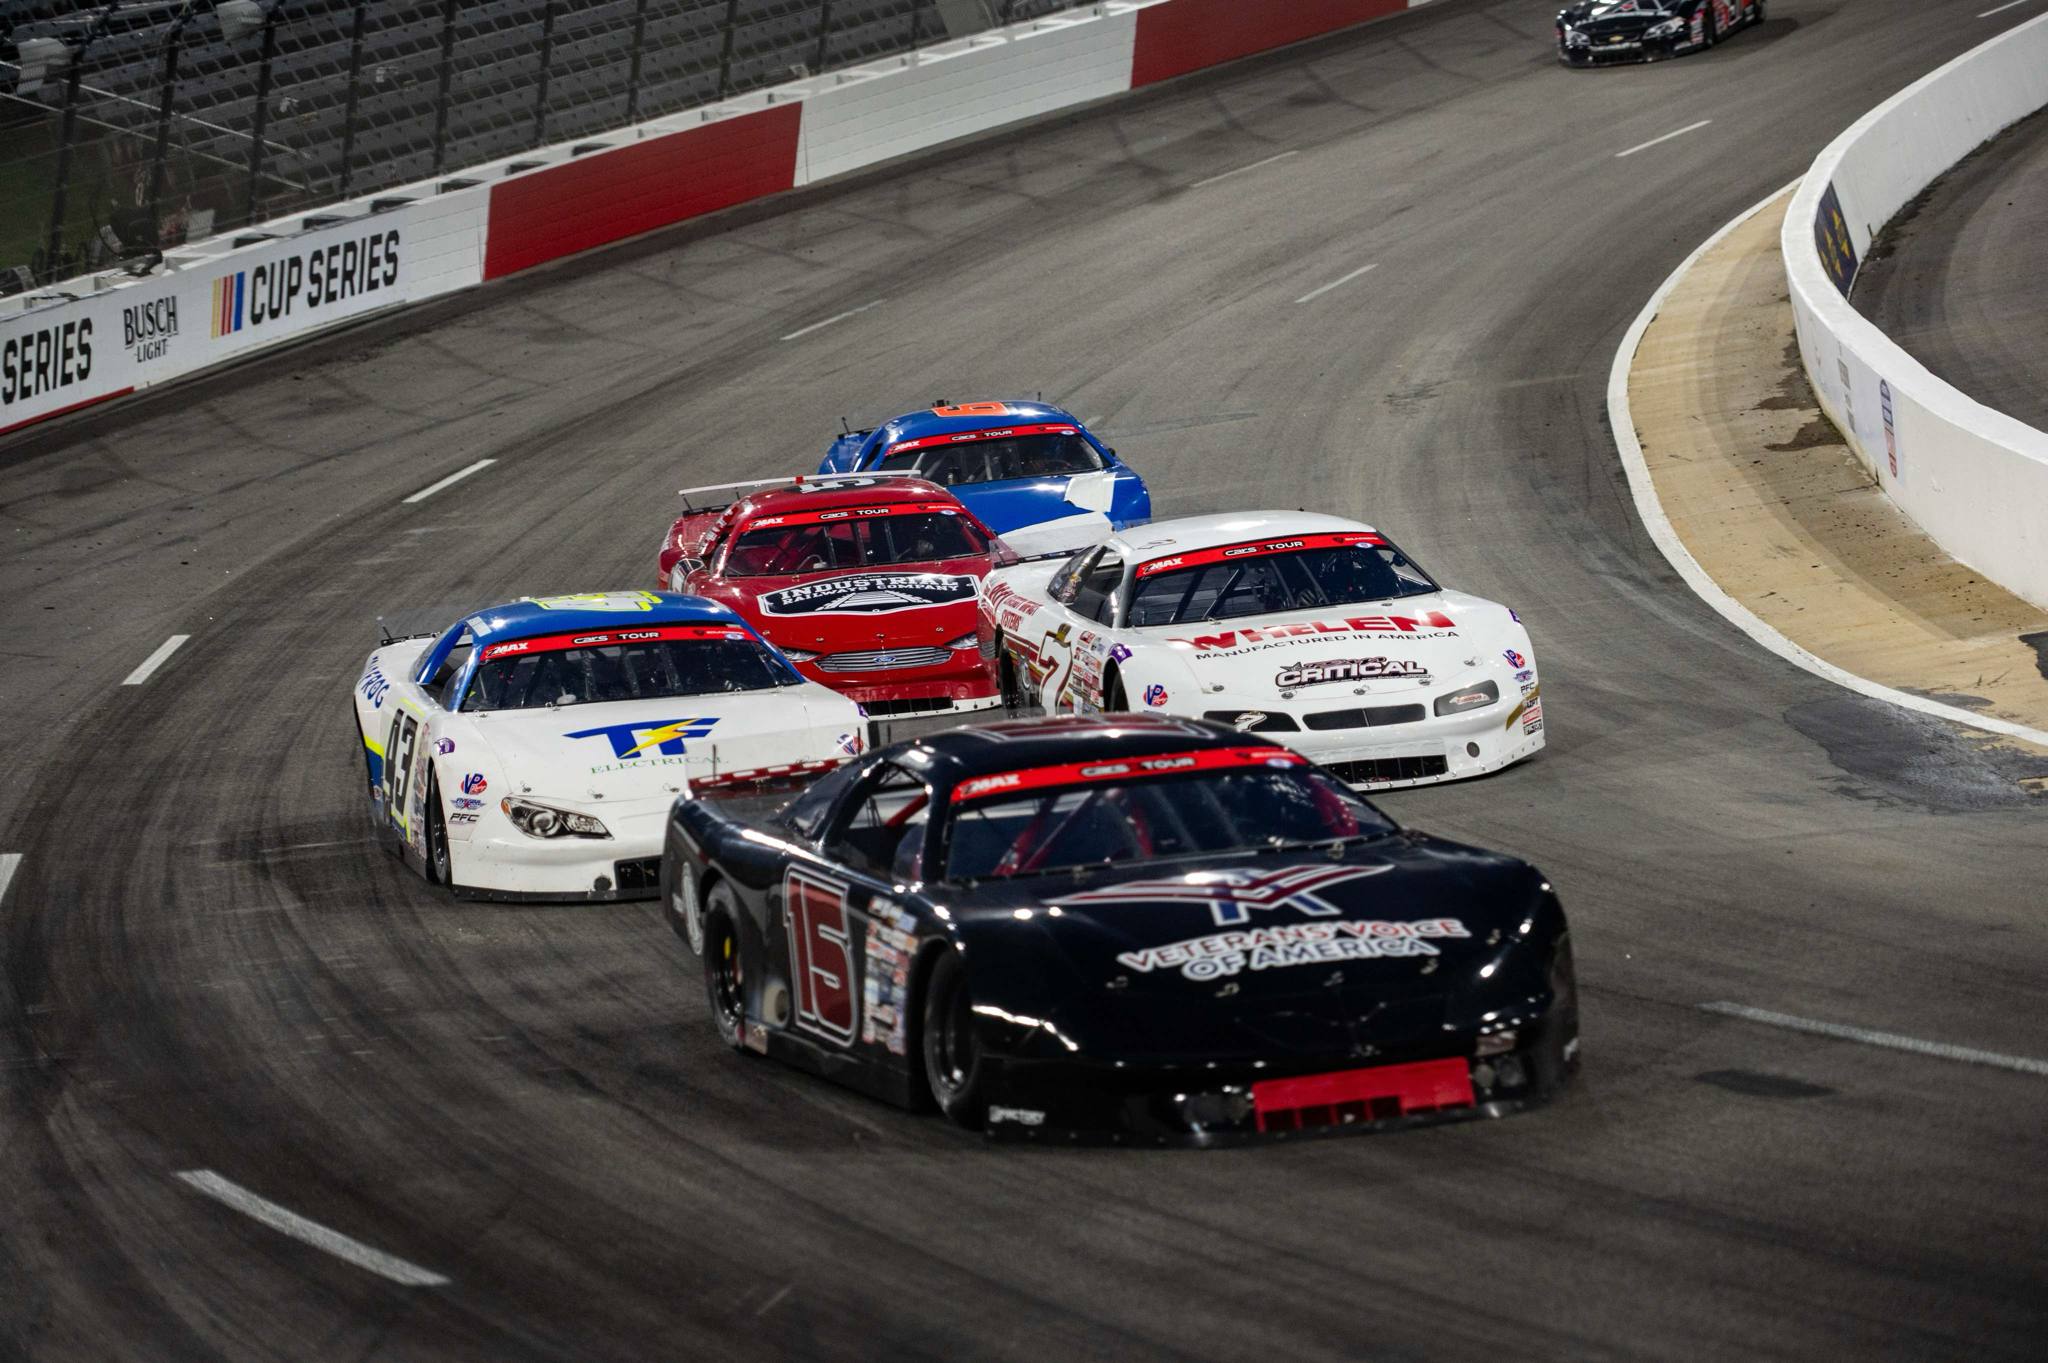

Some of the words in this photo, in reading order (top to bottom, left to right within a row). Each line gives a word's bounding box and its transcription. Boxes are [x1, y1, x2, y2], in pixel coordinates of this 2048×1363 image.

[251, 255, 302, 325] CUP
[308, 230, 400, 307] SERIES
[123, 296, 179, 348] BUSCH
[2, 317, 93, 403] SERIES
[136, 343, 168, 363] LIGHT
[1267, 541, 1303, 550] TOUR
[778, 574, 959, 600] INDUSTRIAL
[782, 585, 868, 606] RAILWAYS
[876, 583, 959, 592] COMPANY
[619, 632, 660, 640] TOUR
[1165, 609, 1457, 650] WHELEN
[1195, 635, 1348, 660] MANUFACTURED
[1378, 631, 1460, 640] AMERICA
[1038, 628, 1073, 718] 7
[1275, 660, 1428, 688] CRITICAL
[1234, 710, 1267, 732] 7
[383, 707, 419, 816] 43
[1141, 757, 1195, 770] TOUR
[464, 773, 484, 795] VP
[449, 812, 480, 823] PFC
[1337, 918, 1473, 940] VOICE
[1181, 950, 1247, 982] OF
[1248, 936, 1441, 971] AMERICA
